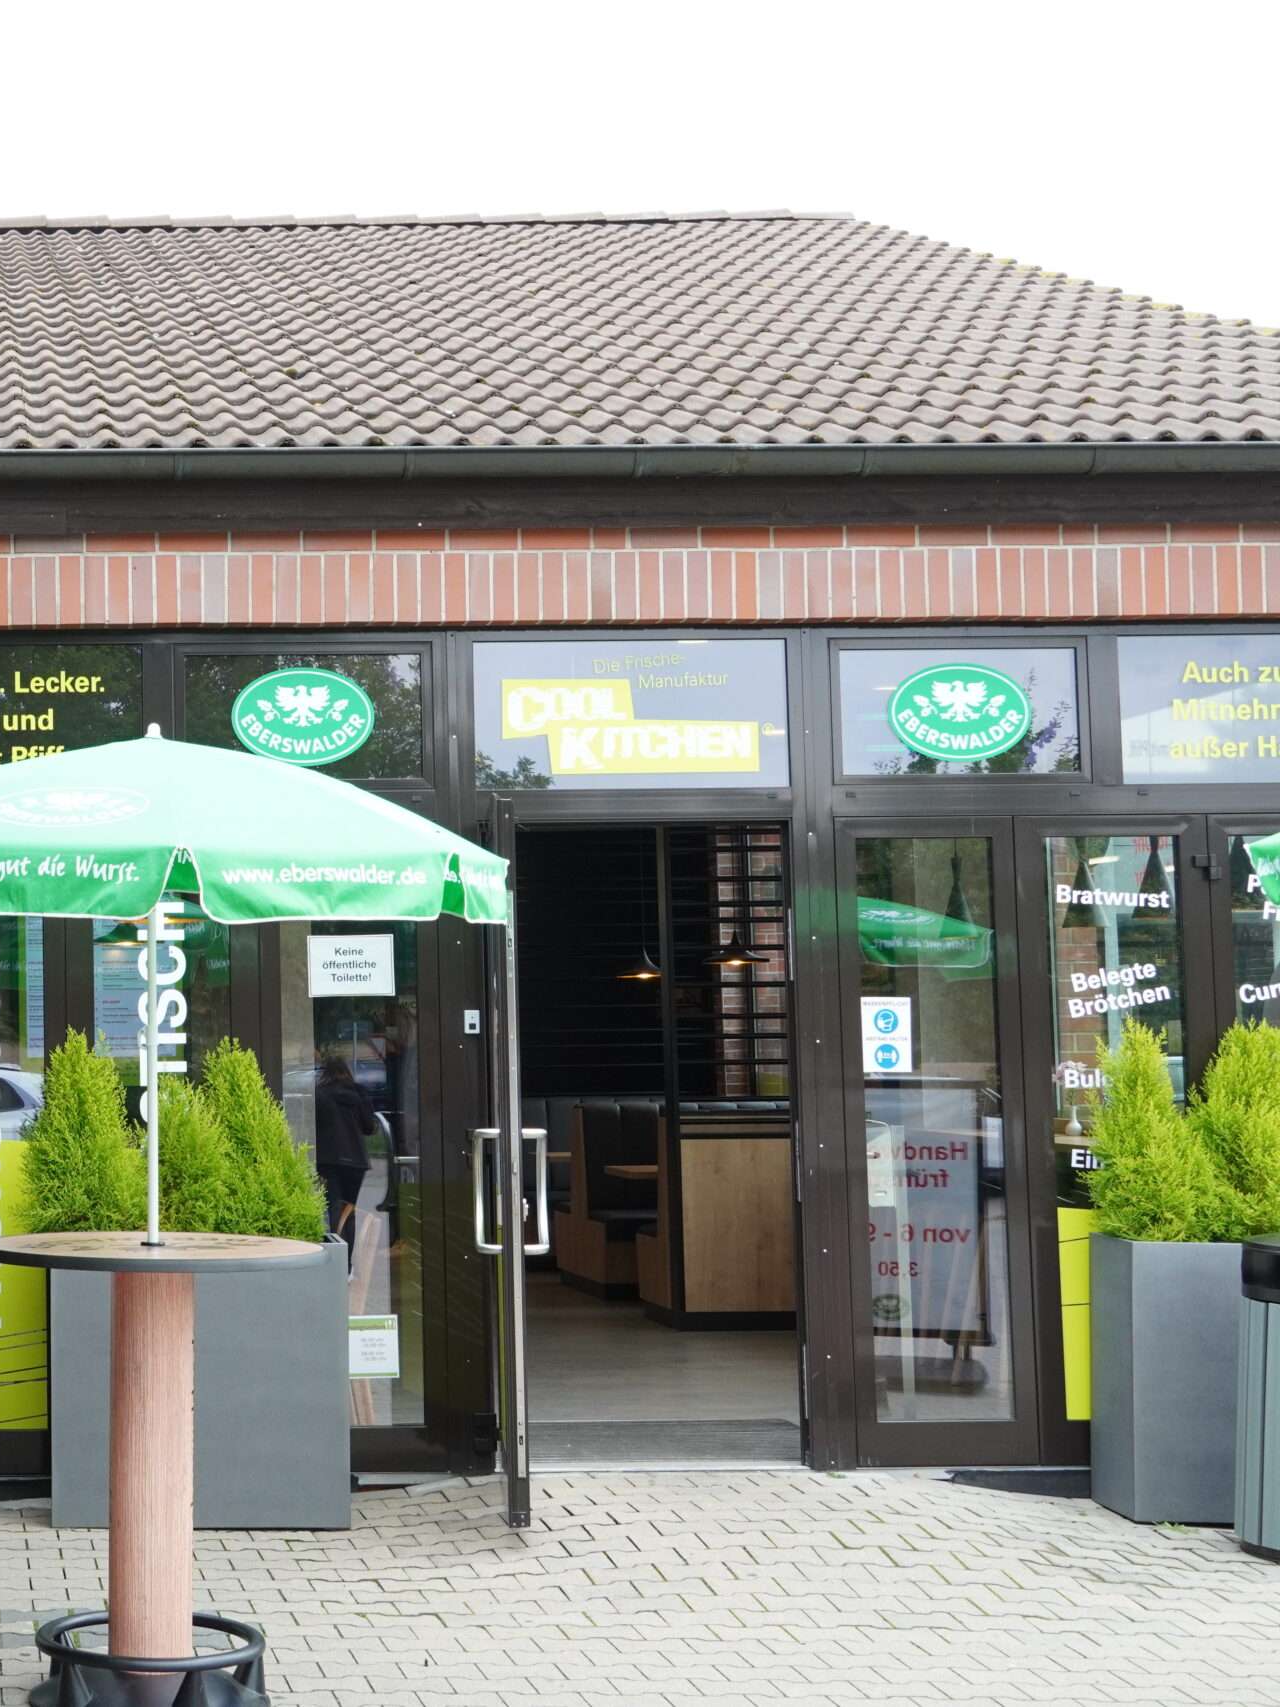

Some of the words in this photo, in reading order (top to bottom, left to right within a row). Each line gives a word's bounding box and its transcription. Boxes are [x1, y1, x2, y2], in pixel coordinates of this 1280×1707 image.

[593, 658, 621, 674] Die
[625, 652, 688, 670] Frische-
[1182, 660, 1249, 683] Auch
[14, 670, 106, 694] Lecker.
[638, 672, 730, 690] Manufaktur
[2, 708, 54, 731] und
[507, 687, 627, 733] COOL
[240, 711, 368, 756] EBERSWALDER
[896, 708, 1024, 751] EBERSWALDER
[559, 723, 753, 770] KITCHEN
[1169, 735, 1249, 759] außer
[38, 853, 66, 877] die
[223, 863, 428, 886] www.eberswalder.de
[1056, 883, 1170, 909] Bratwurst
[334, 947, 365, 957] Keine
[322, 959, 377, 970] öffentliche
[331, 973, 372, 983] Toilette!
[1070, 962, 1157, 993] Belegte
[1068, 985, 1171, 1019] Brötchen
